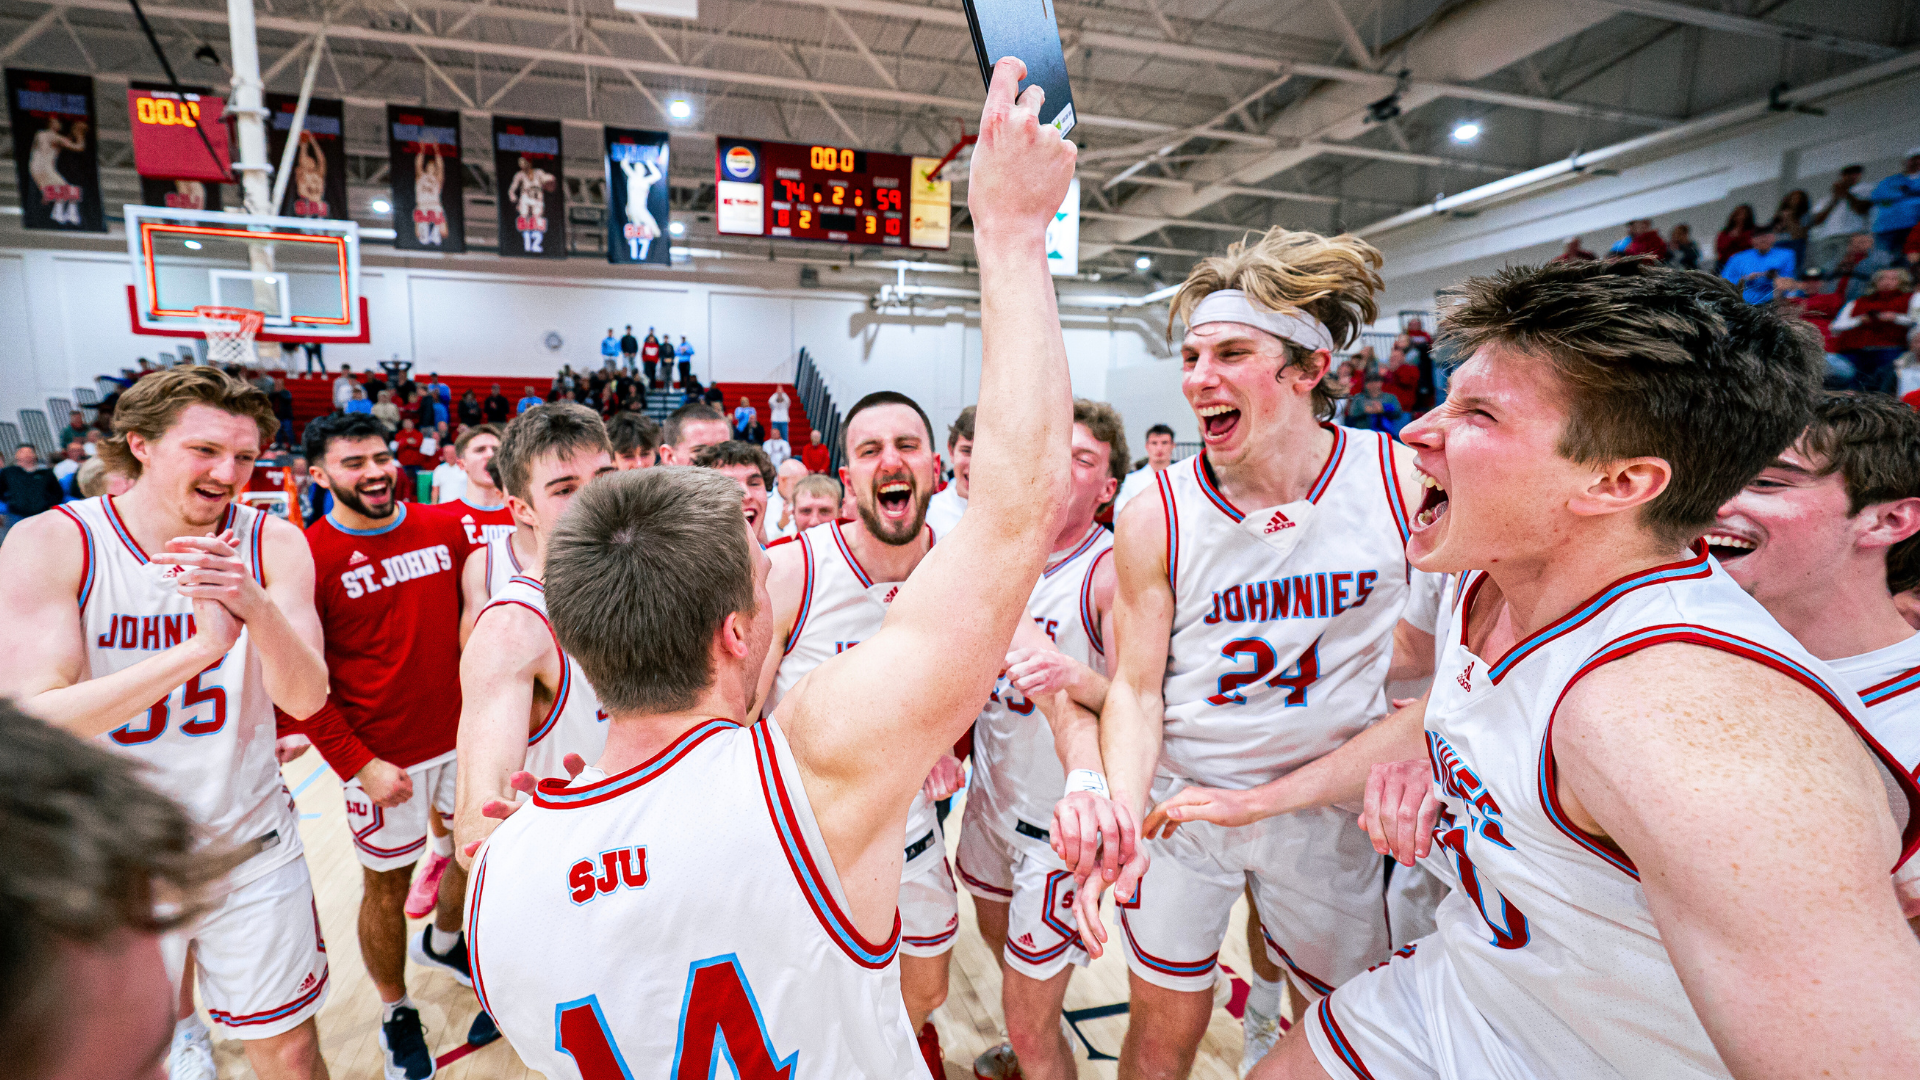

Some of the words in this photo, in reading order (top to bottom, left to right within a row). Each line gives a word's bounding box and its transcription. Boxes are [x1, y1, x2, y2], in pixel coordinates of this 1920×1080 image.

[811, 146, 855, 172] 00.0
[780, 179, 805, 202] 74
[832, 186, 845, 205] 2
[876, 188, 902, 210] 59
[799, 210, 812, 229] 2
[865, 215, 877, 234] 3
[522, 230, 544, 253] 12
[630, 237, 652, 260] 17
[1203, 569, 1379, 625] JOHNNIES
[1203, 630, 1326, 708] 24
[108, 653, 229, 747] 35
[566, 845, 650, 907] SJU
[554, 951, 800, 1080] 14
